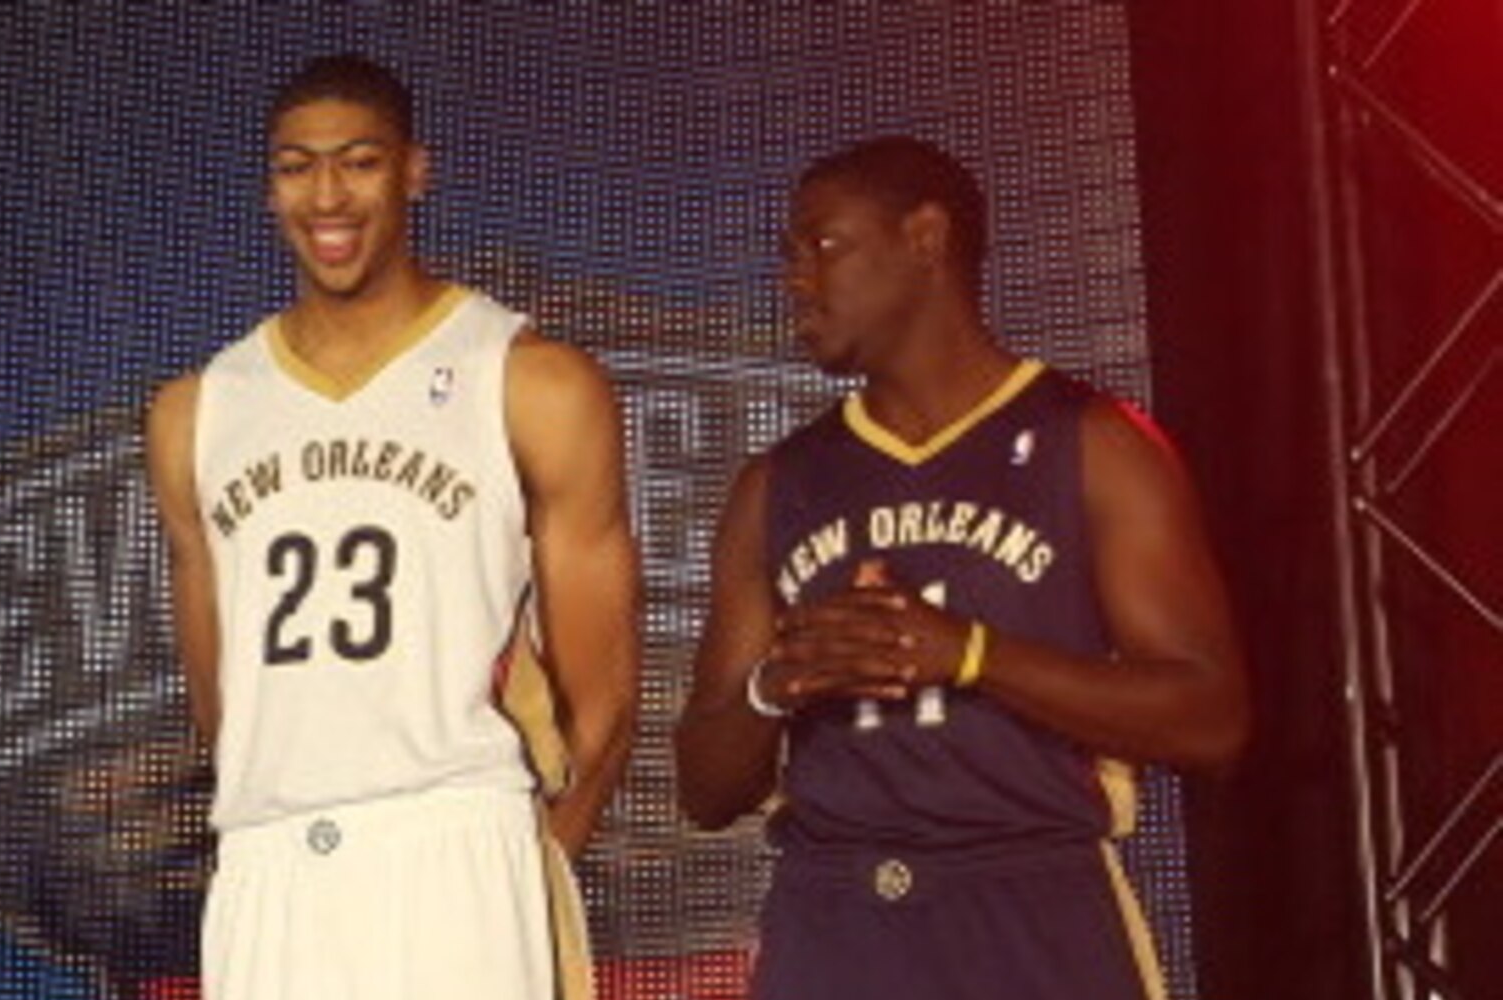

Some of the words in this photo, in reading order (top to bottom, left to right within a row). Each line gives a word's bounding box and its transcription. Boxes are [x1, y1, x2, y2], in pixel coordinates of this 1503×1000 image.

[210, 453, 282, 538] NEW
[301, 439, 476, 521] ORLEANS
[868, 501, 1054, 582] ORLEANS
[263, 525, 398, 665] 23
